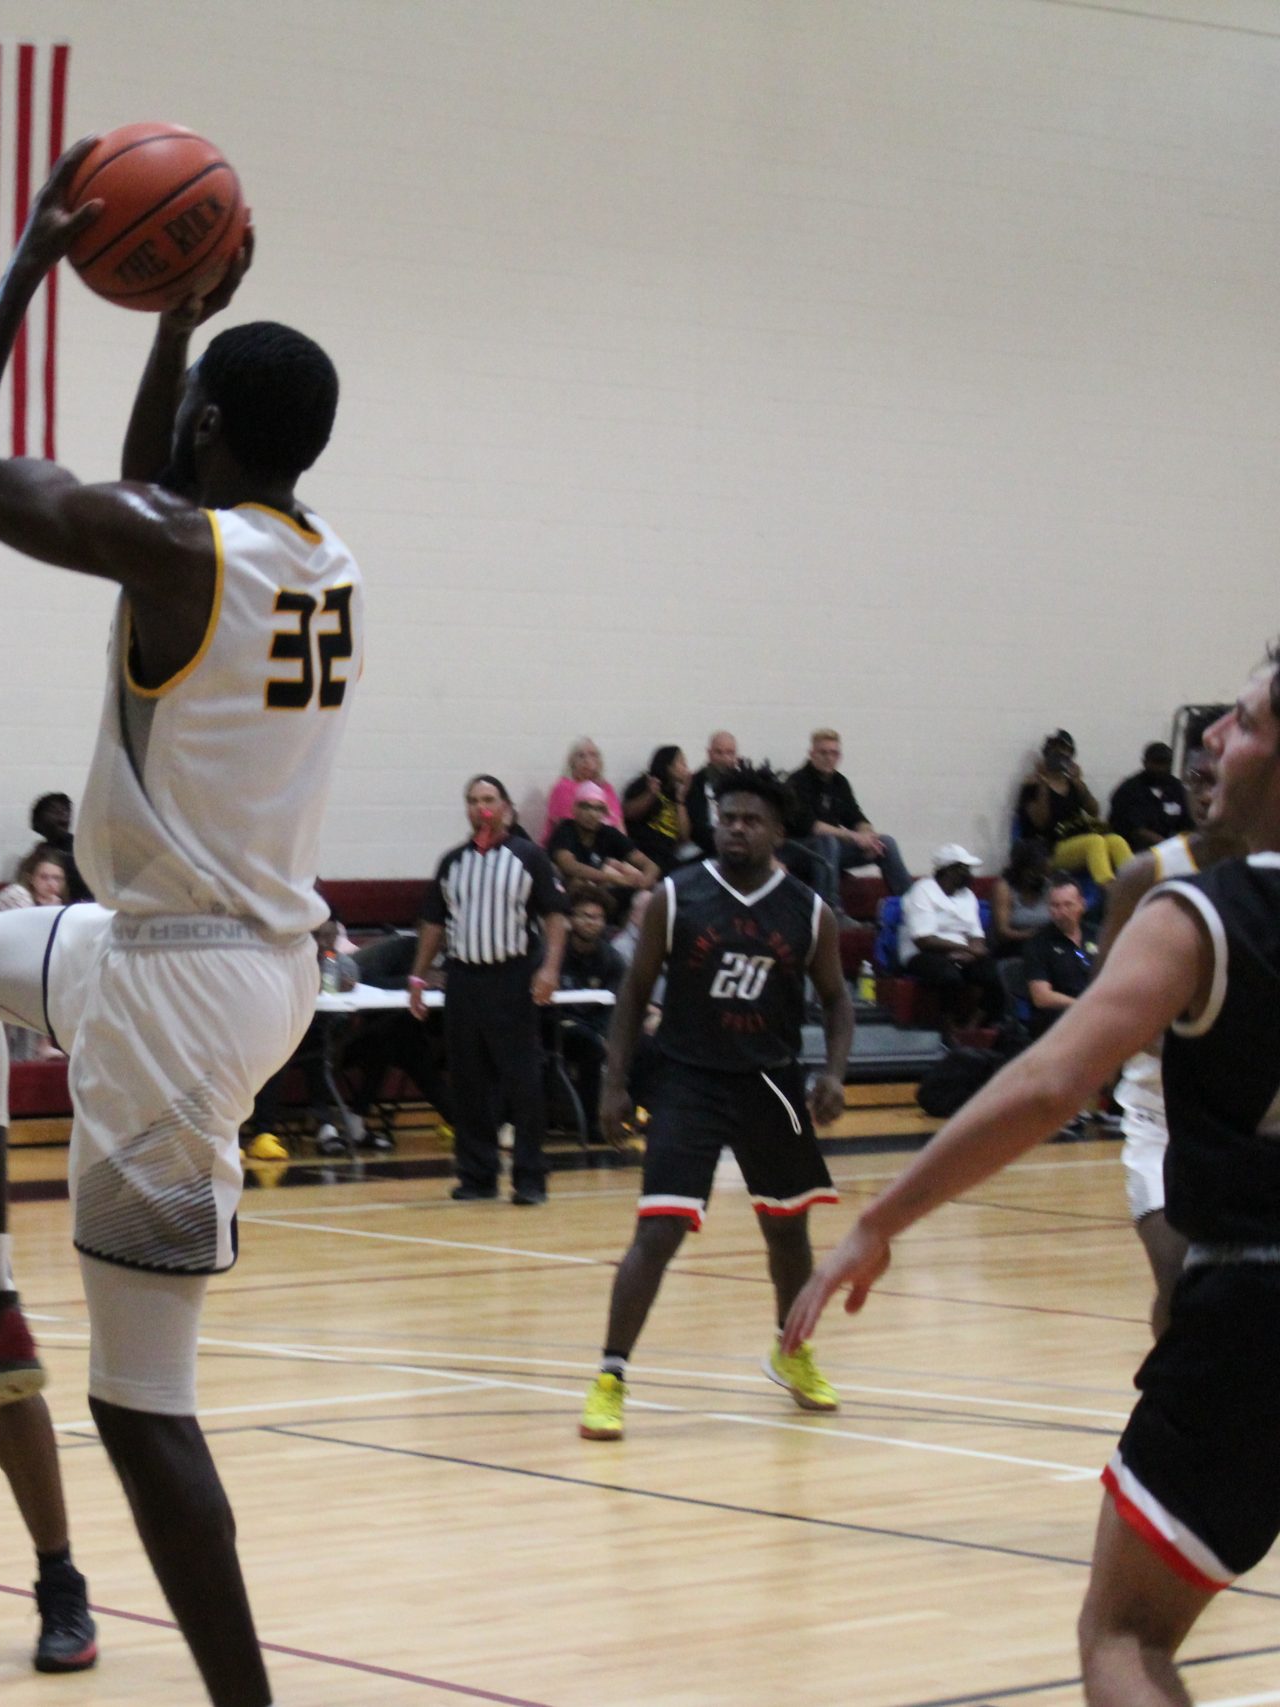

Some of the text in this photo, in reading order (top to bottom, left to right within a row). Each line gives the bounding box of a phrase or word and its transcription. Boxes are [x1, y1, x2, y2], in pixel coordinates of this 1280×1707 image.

[115, 239, 170, 284] THE
[264, 583, 354, 711] 32
[708, 951, 777, 1001] 20
